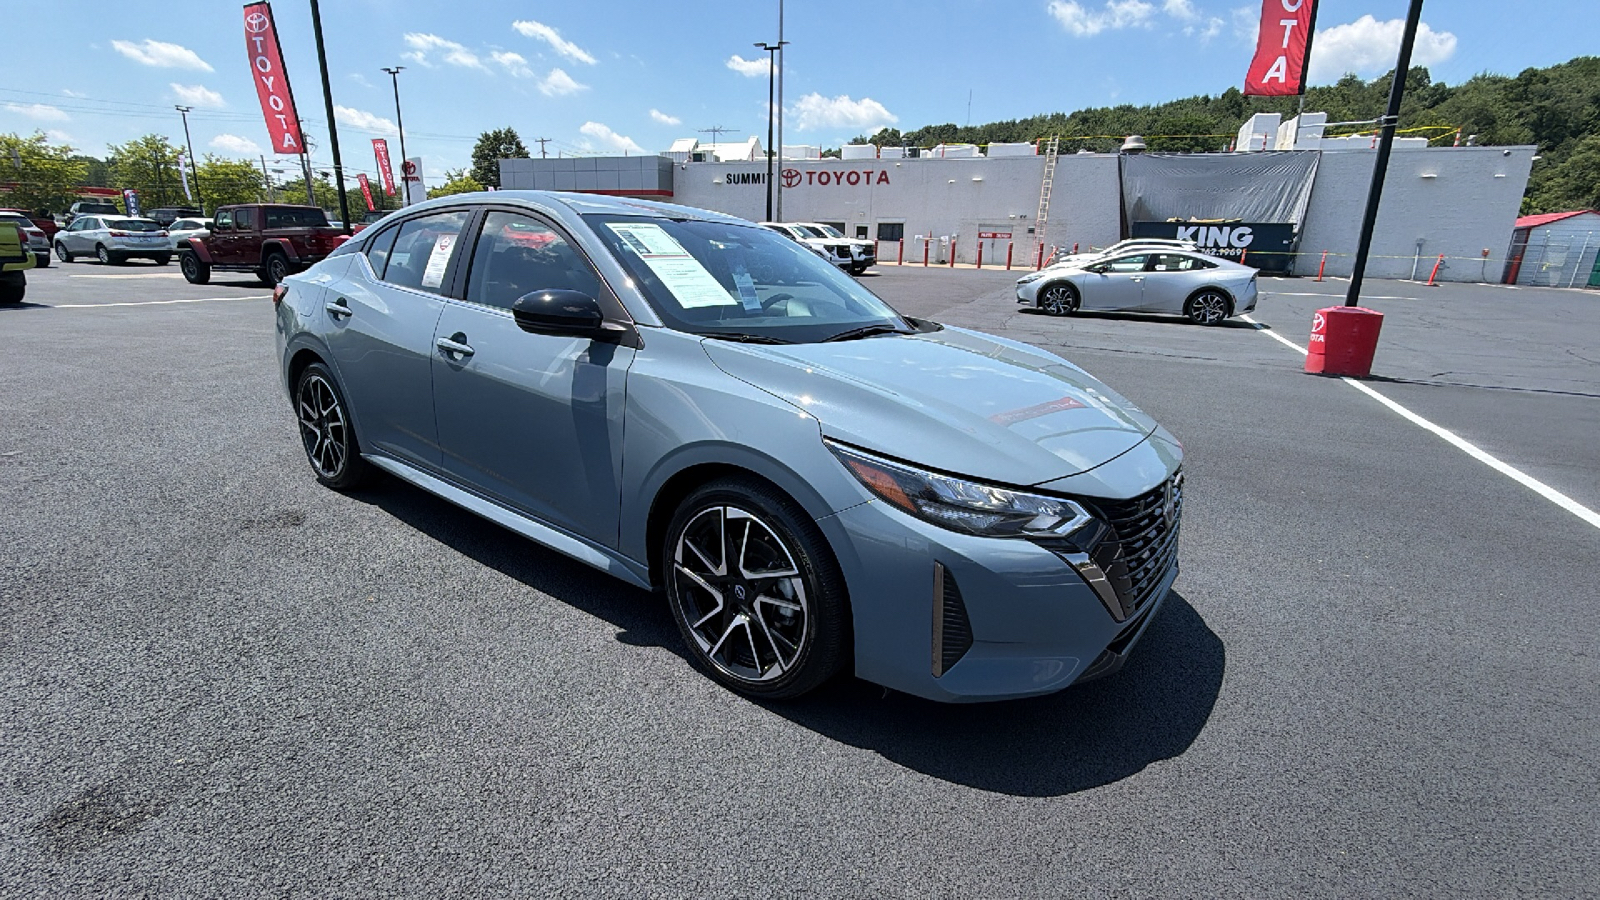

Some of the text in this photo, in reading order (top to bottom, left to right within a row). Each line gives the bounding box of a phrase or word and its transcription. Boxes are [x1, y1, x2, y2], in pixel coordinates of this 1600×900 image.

[252, 37, 297, 148] TOYOTA
[806, 170, 890, 186] TOYOTA
[1176, 226, 1254, 248] KING
